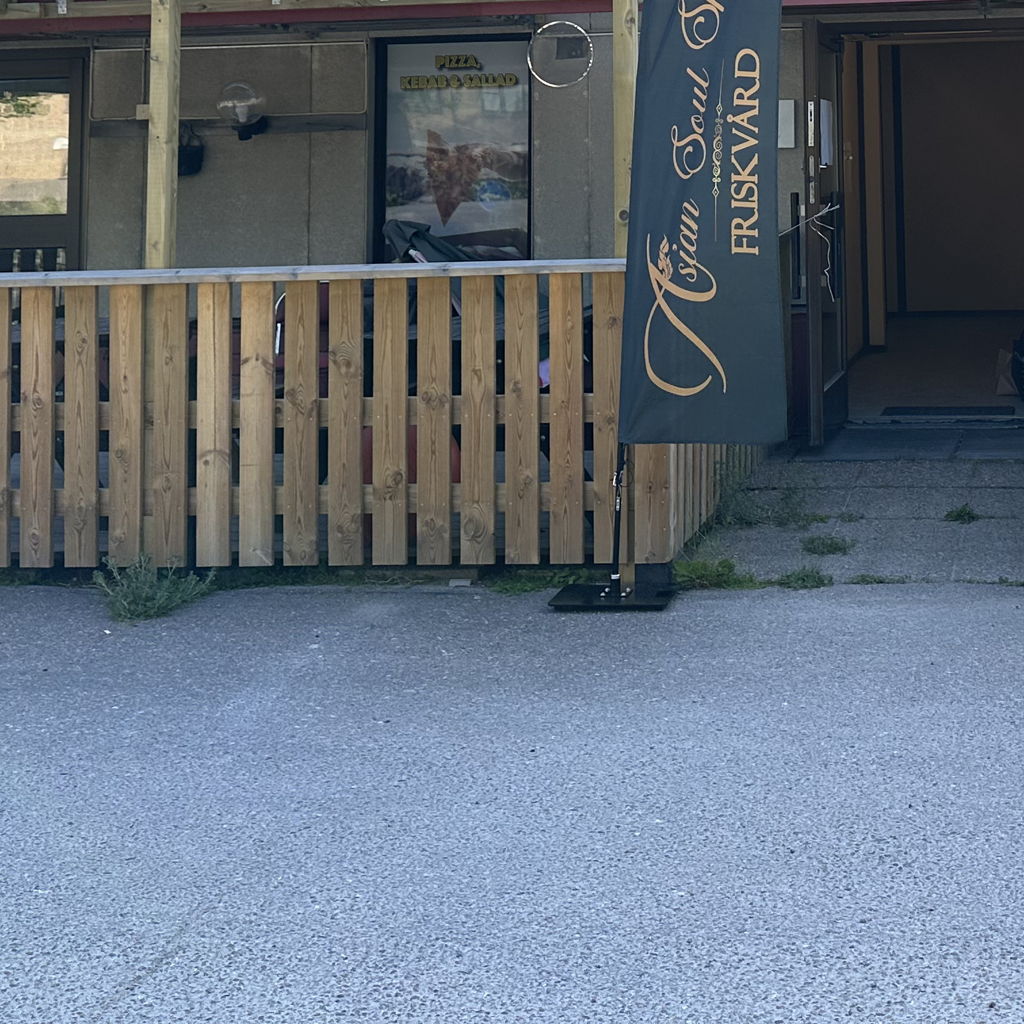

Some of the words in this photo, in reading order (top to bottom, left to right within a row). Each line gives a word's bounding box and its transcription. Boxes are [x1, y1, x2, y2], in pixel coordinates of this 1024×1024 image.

[399, 75, 447, 89] KEBAB
[463, 72, 519, 87] SALLAD
[670, 66, 710, 180] Soul
[726, 47, 761, 256] FRISKVÅRD
